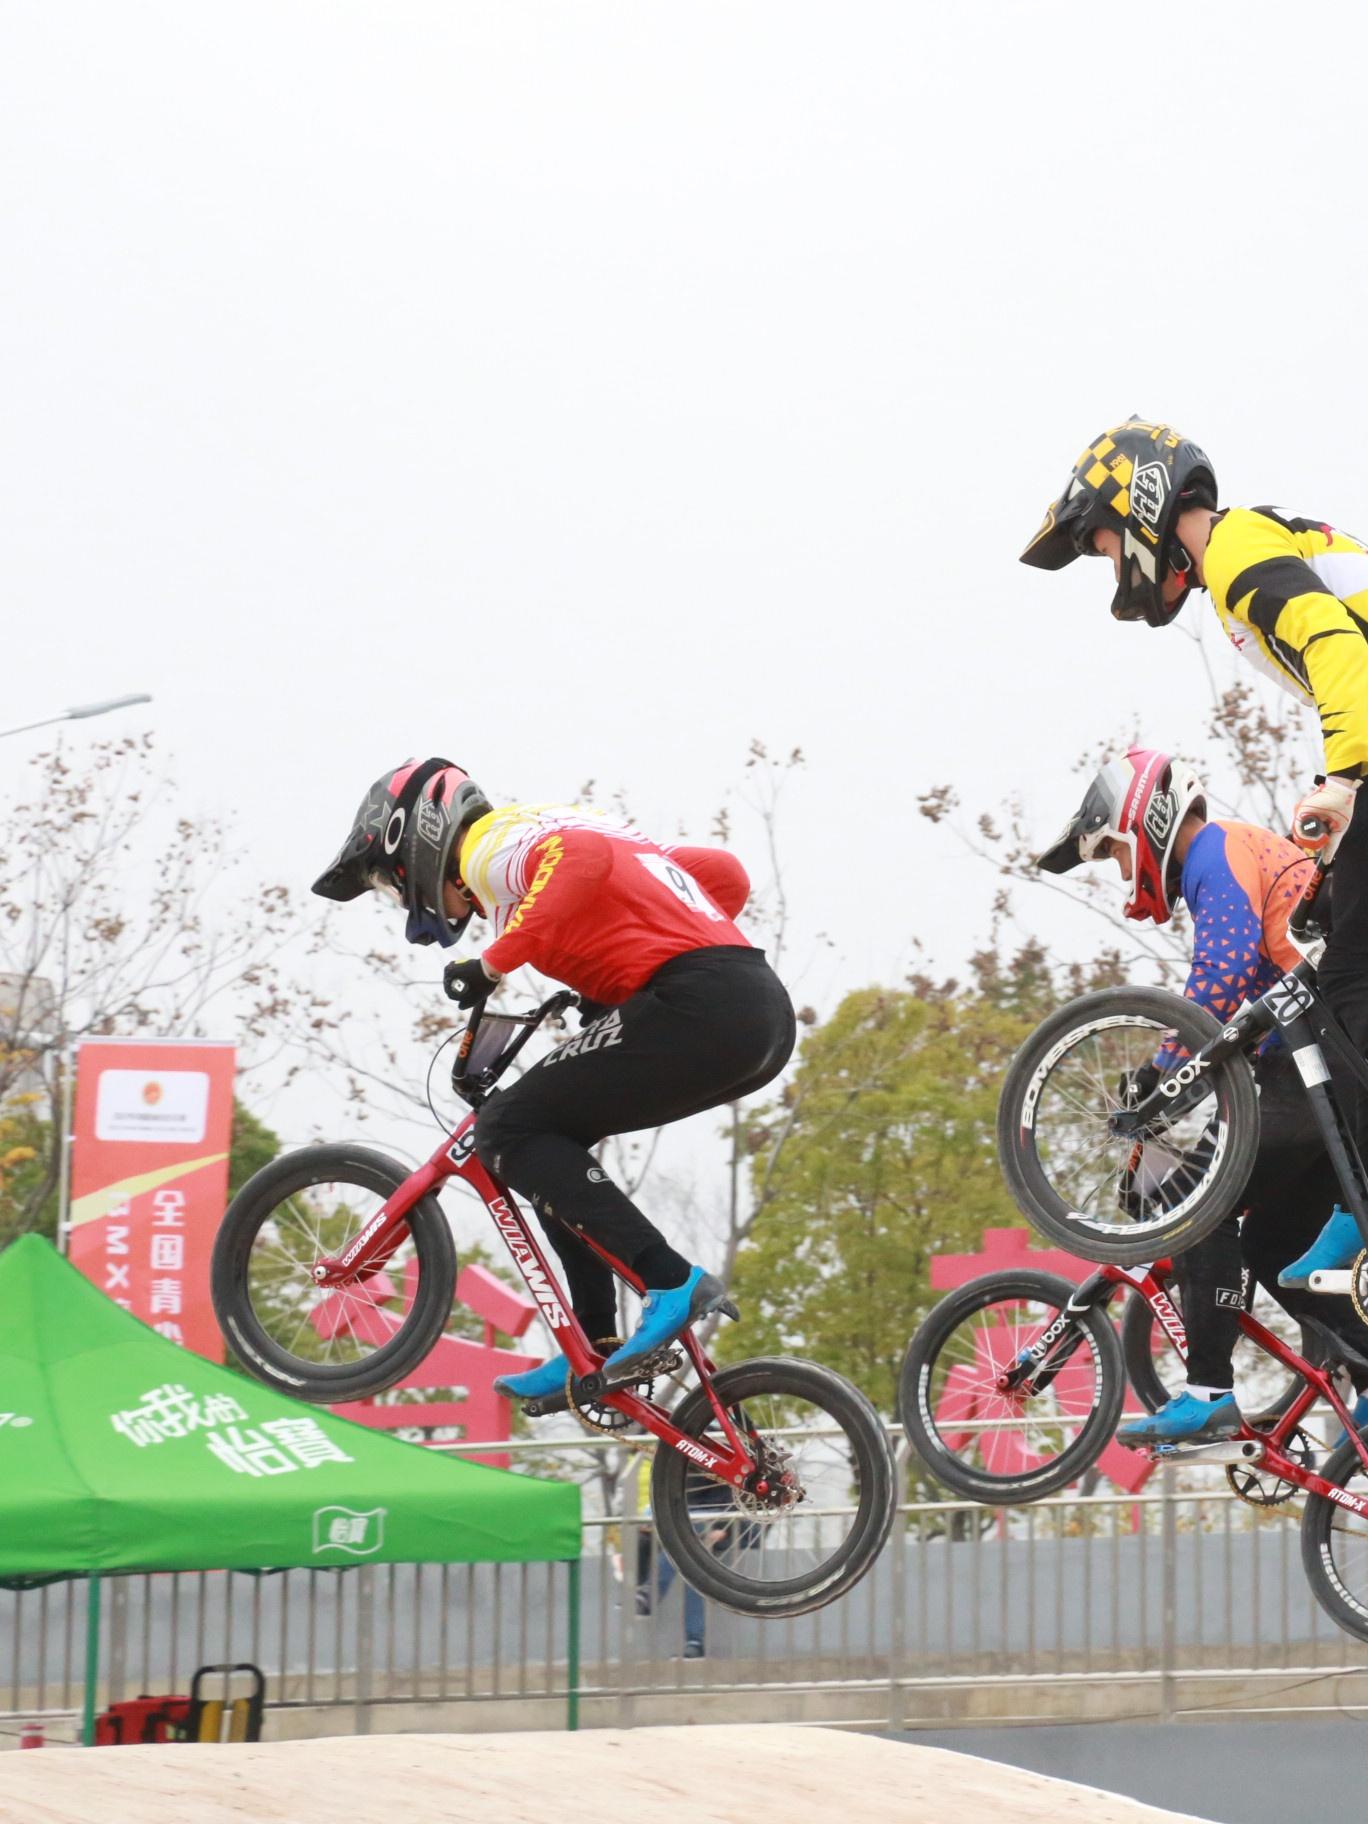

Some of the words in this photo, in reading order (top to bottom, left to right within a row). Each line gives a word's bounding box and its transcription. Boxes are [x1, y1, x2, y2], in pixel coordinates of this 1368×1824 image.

[1262, 975, 1312, 1023] 20
[543, 1024, 624, 1068] CRUZ
[341, 1211, 388, 1268] WIAWIS
[488, 1195, 571, 1330] WIAWIS
[675, 1439, 718, 1469] ATOM-X
[1327, 1487, 1366, 1512] ATOM-X
